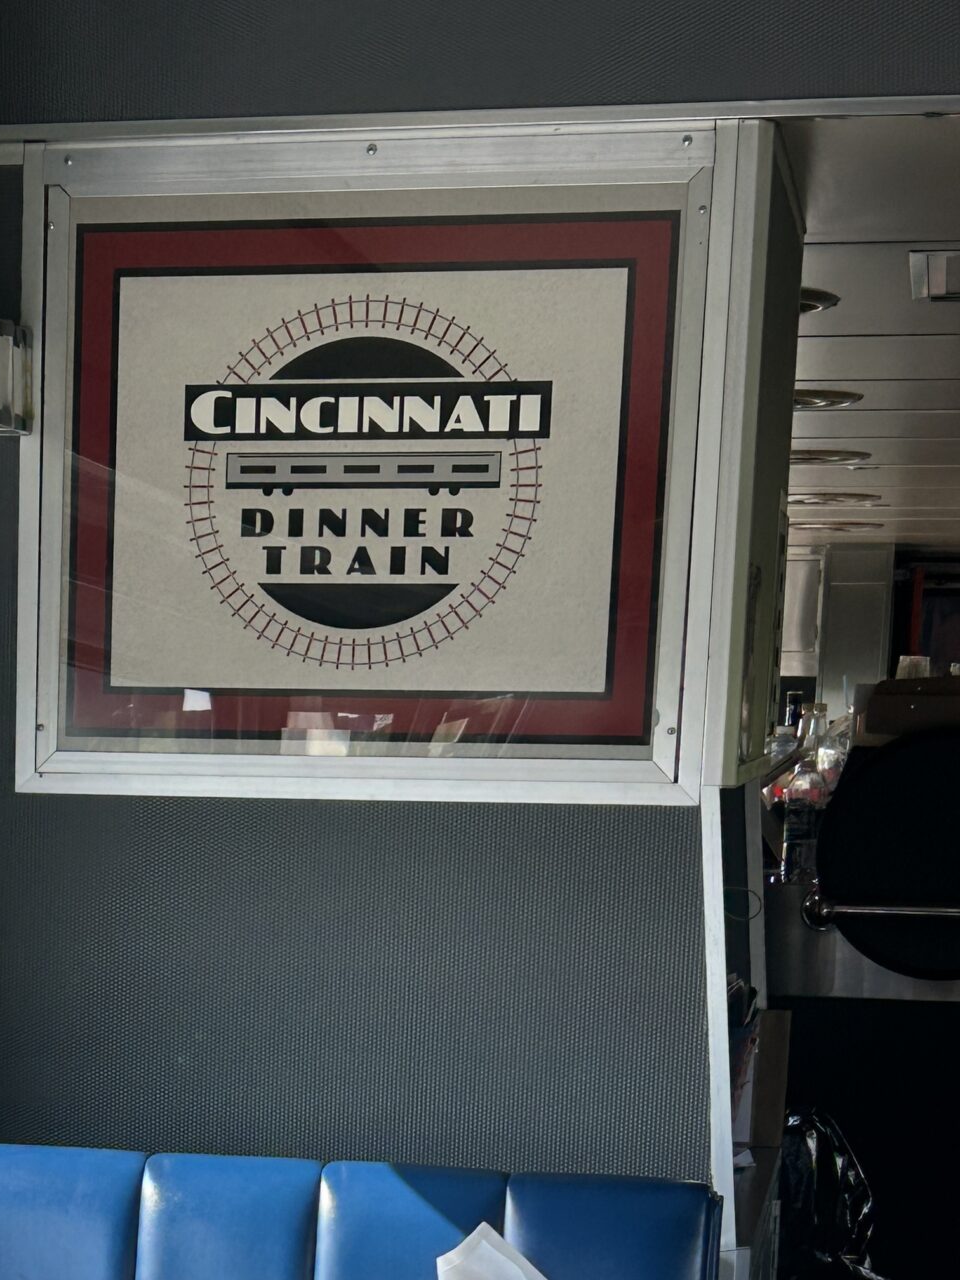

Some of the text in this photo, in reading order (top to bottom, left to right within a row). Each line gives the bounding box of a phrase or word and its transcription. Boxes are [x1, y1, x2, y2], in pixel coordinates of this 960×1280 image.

[190, 389, 542, 434] CINCINNATI
[240, 507, 475, 538] DINNER
[262, 545, 450, 576] TRAIN
